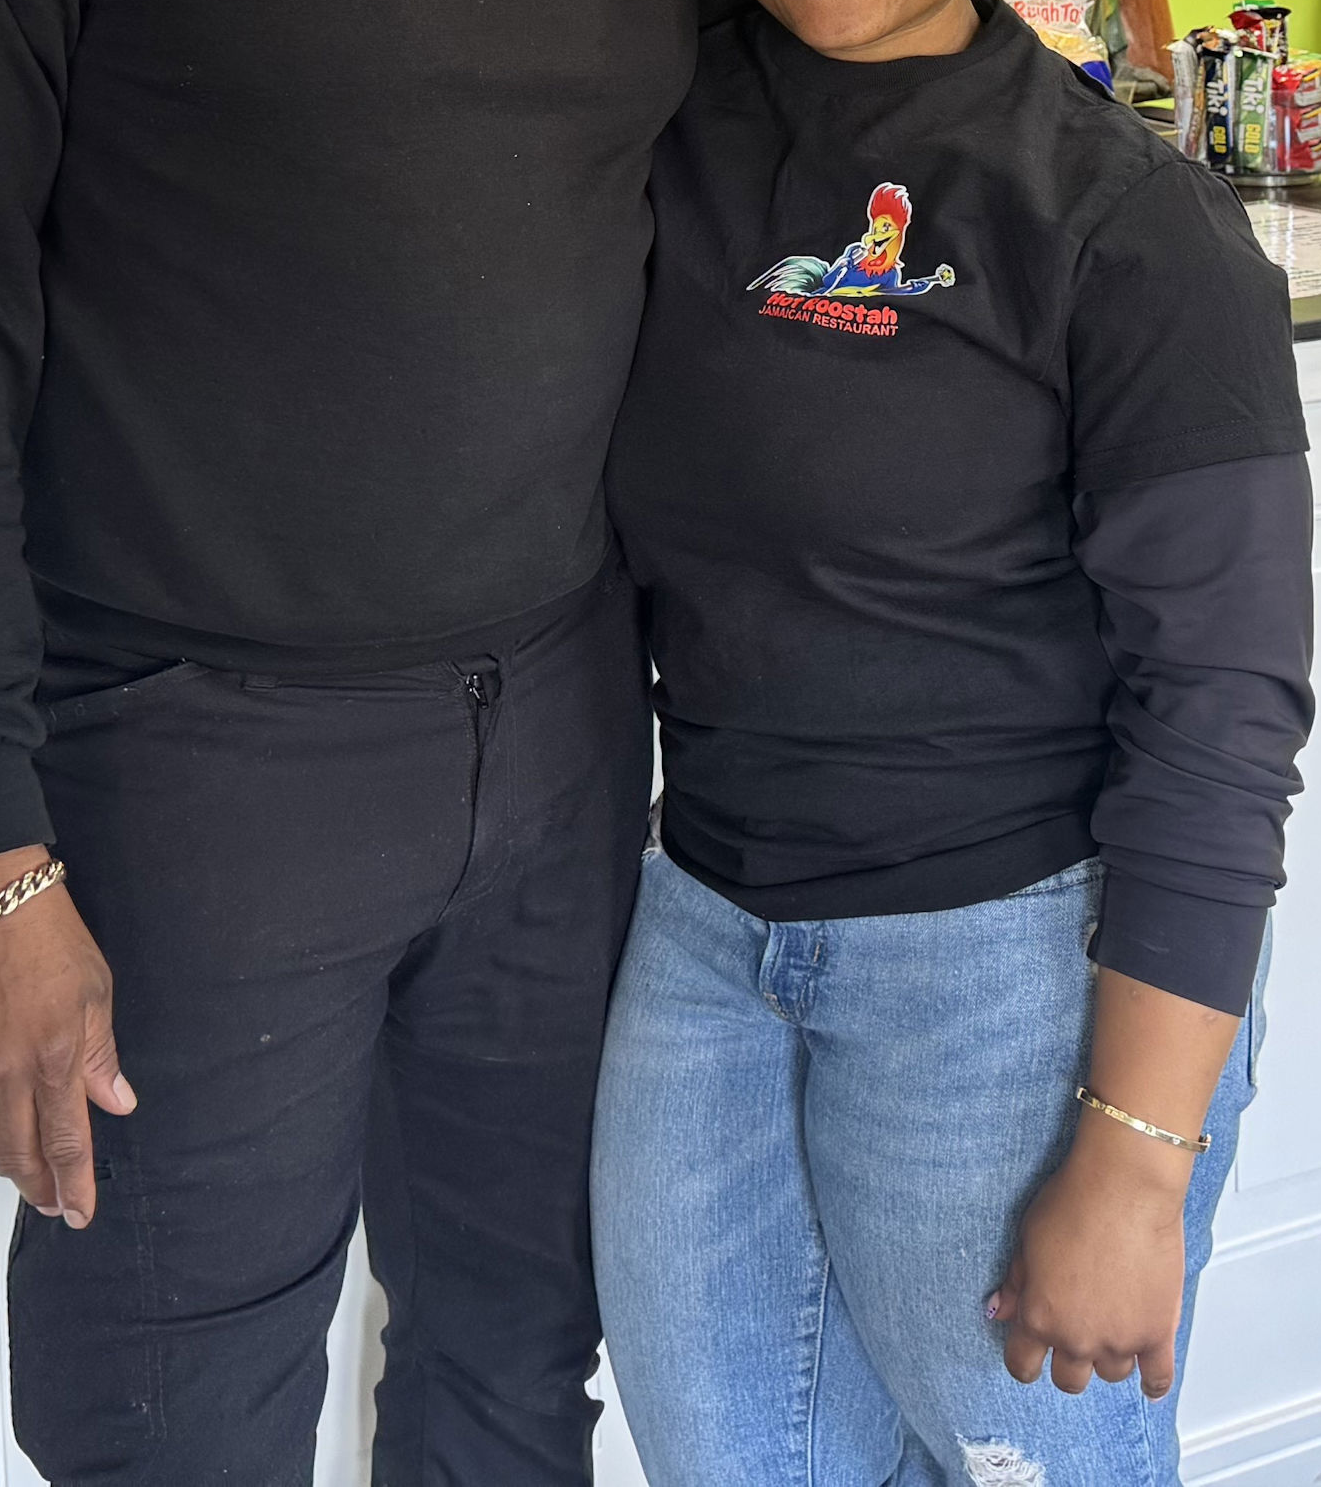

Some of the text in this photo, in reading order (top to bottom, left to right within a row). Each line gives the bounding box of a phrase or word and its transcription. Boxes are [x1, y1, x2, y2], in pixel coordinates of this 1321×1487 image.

[758, 305, 899, 337] JAMAICAN RESTAURANT
[802, 296, 898, 325] Roostah
